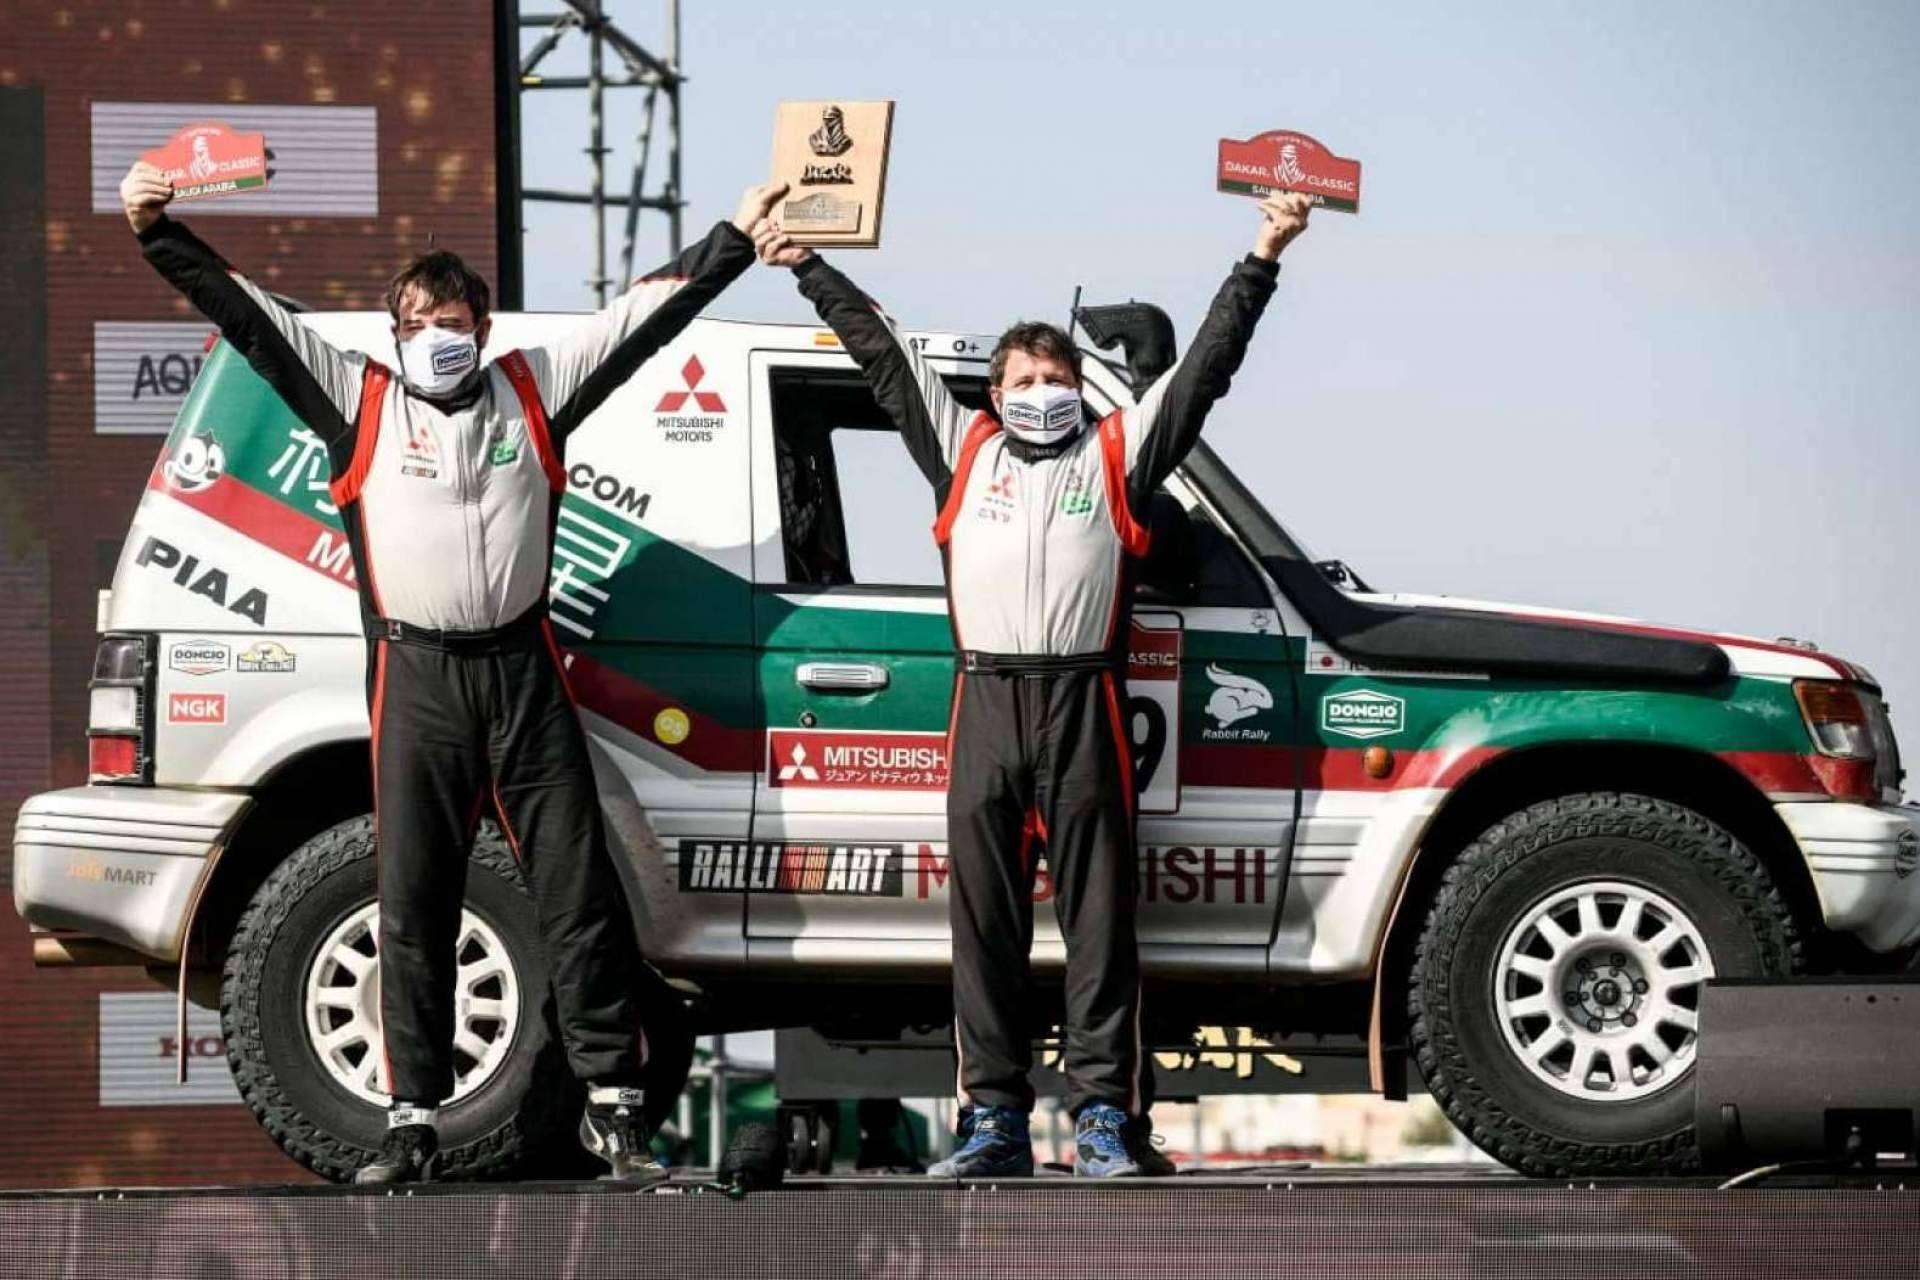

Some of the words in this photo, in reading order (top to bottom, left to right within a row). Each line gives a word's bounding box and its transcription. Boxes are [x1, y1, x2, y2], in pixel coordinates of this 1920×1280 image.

[1223, 160, 1272, 177] DAKAR
[1307, 175, 1355, 192] CLASSIC
[656, 416, 725, 428] MITSUBISHI
[664, 430, 713, 442] MOTORS
[135, 535, 269, 627] PIAA
[171, 699, 221, 718] NGK
[1328, 702, 1398, 719] DONCIO
[1202, 728, 1240, 740] Rabbit
[1241, 728, 1271, 742] Rally
[826, 846, 893, 892] ART
